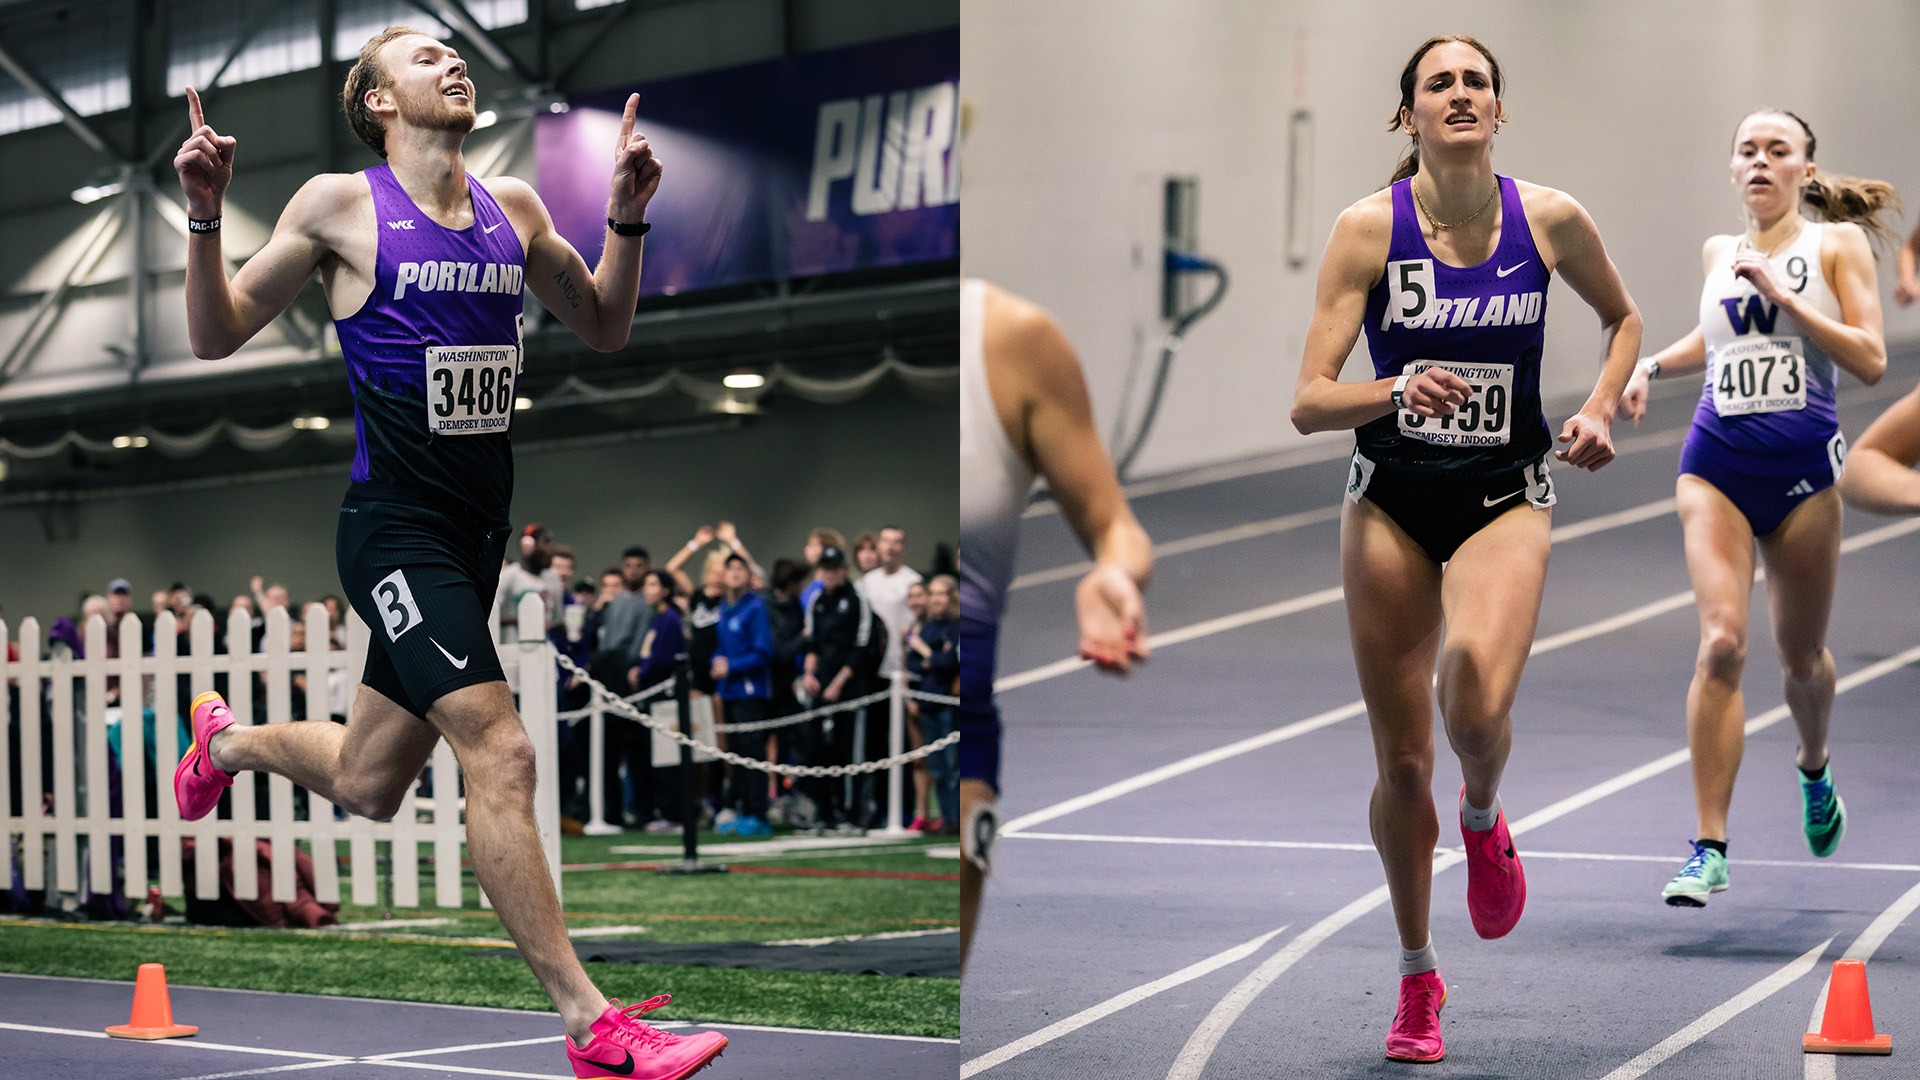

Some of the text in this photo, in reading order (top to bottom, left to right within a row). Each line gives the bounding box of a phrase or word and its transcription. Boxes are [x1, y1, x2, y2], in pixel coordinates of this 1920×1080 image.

[190, 220, 219, 230] PAC-12
[393, 260, 523, 300] PORTLAND
[1400, 263, 1427, 318] 5
[1786, 256, 1808, 294] 9
[1380, 291, 1543, 332] RTLAND
[1720, 294, 1779, 336] W
[438, 351, 509, 362] WASHINGTON
[432, 366, 512, 417] 3486
[1719, 355, 1800, 399] 4073
[438, 417, 507, 430] DEMPSEY INDOOR
[1460, 435, 1502, 445] INDOOR
[378, 581, 410, 636] 3
